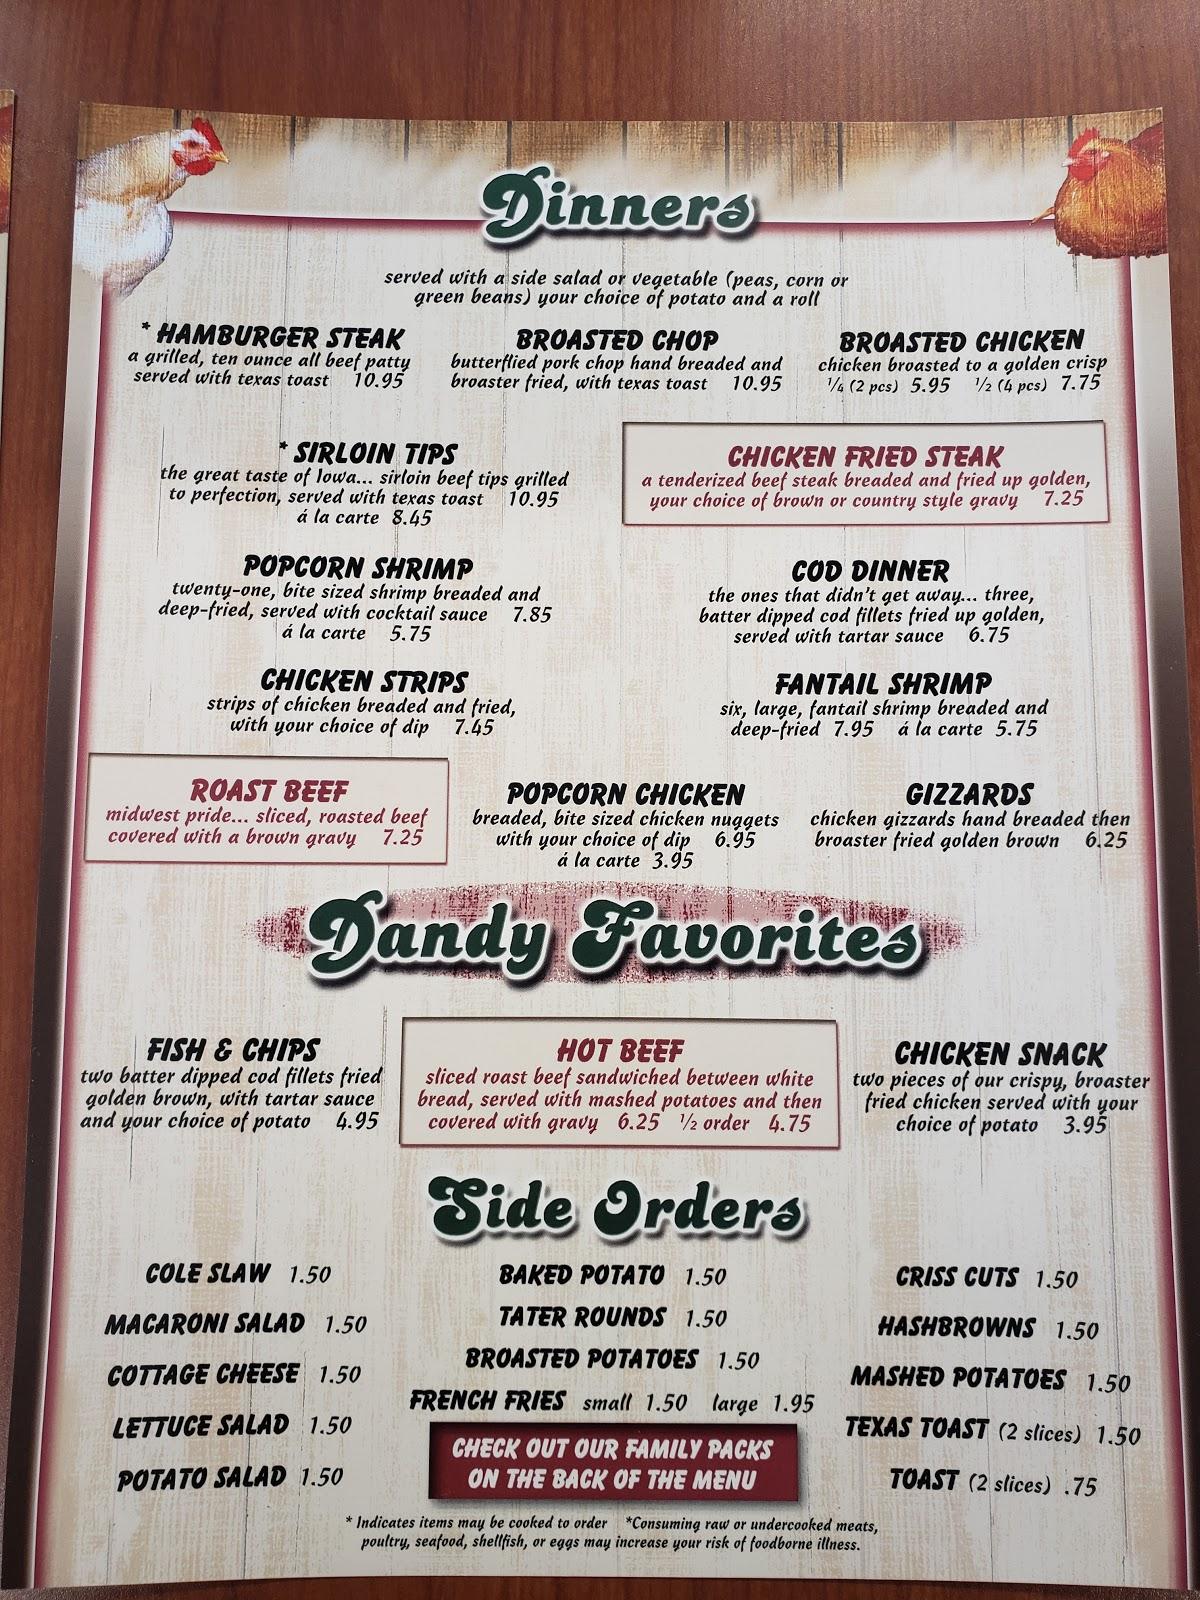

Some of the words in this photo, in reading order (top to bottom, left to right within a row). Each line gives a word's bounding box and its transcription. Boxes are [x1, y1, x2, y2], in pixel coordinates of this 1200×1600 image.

[479, 164, 754, 241] Dinners
[384, 268, 444, 284] served
[449, 268, 488, 285] with
[493, 274, 505, 285] a
[507, 268, 547, 286] side
[552, 268, 603, 286] salad
[608, 273, 626, 286] or
[632, 270, 718, 290] vegetable
[726, 270, 778, 291] (peas,
[786, 276, 824, 288] corn
[830, 276, 849, 288] or
[156, 322, 320, 350] HAMBURGER
[326, 327, 406, 351] STEAK
[516, 328, 644, 352] BROASTED
[652, 329, 719, 352] CHOP
[839, 331, 967, 354] BROASTED
[976, 328, 1085, 353] CHICKEN
[133, 368, 191, 384] served
[195, 369, 232, 385] with
[238, 373, 282, 387] texas
[287, 374, 330, 387] toast
[355, 372, 405, 389] 10.95
[293, 441, 396, 466] SIRLOIN
[405, 442, 459, 466] TIPS
[728, 445, 837, 470] CHICKEN
[844, 446, 918, 470] FRIED
[924, 445, 1005, 469] STEAK
[243, 554, 365, 580] POPCORN
[371, 556, 474, 582] SHRIMP
[792, 559, 843, 582] COD
[851, 559, 950, 584] DINNER
[733, 627, 790, 644] served
[795, 626, 832, 644] with
[838, 630, 890, 644] tartar
[894, 632, 944, 643] sauce
[968, 626, 1010, 644] 6.75
[260, 668, 374, 694] CHICKEN
[380, 670, 470, 695] STRIPS
[775, 672, 879, 696] FANTAIL
[888, 672, 992, 697] SHRIMP
[190, 778, 278, 804] ROAST
[283, 779, 350, 803] BEEF
[507, 782, 628, 807] POPCORN
[635, 782, 746, 808] CHICKEN
[906, 782, 1035, 808] GIZZARDS
[108, 826, 179, 844] covered
[184, 826, 222, 844] with
[228, 833, 240, 844] a
[246, 827, 300, 844] brown
[305, 832, 357, 850] gravy
[383, 828, 424, 846] 7.25
[306, 888, 550, 978] Dandy
[569, 897, 920, 970] Favorites
[146, 1037, 207, 1062] FISH
[214, 1037, 232, 1062] &
[242, 1037, 322, 1062] CHIPS
[557, 1038, 614, 1063] HOT
[619, 1038, 685, 1063] BEEF
[894, 1040, 1011, 1068] CHICKEN
[1018, 1042, 1108, 1068] SNACK
[896, 1114, 952, 1132] choice
[958, 1114, 977, 1136] of
[980, 1118, 1038, 1137] potato
[1063, 1115, 1108, 1134] 3.95
[427, 1174, 573, 1237] Side
[593, 1179, 802, 1236] Orders
[146, 1262, 203, 1284] COLE
[206, 1262, 272, 1284] SLAW
[290, 1265, 332, 1284] 1.50
[499, 1264, 573, 1286] BAKED
[580, 1264, 665, 1286] POTATO
[686, 1268, 727, 1287] 1.50
[896, 1265, 958, 1288] CRISS
[964, 1266, 1020, 1288] CUTS
[1036, 1270, 1078, 1290] 1.50
[104, 1312, 230, 1336] MACARONI
[234, 1312, 306, 1334] SALAD
[326, 1315, 368, 1334] 1.50
[499, 1306, 567, 1328] TATER
[574, 1306, 668, 1328] ROUNDS
[686, 1309, 728, 1328] 1.50
[878, 1315, 1037, 1339] HASHBROWNS
[1056, 1321, 1099, 1341] 1.50
[465, 1347, 580, 1370] BROASTED
[587, 1348, 700, 1370] POTATOES
[719, 1352, 760, 1370] 1.50
[107, 1363, 211, 1387] COTTAGE
[216, 1361, 301, 1385] CHEESE
[320, 1365, 362, 1384] 1.50
[850, 1365, 945, 1388] MASHED
[952, 1366, 1068, 1390] POTATOES
[1088, 1373, 1131, 1394] 1.50
[409, 1389, 498, 1412] FRENCH
[504, 1390, 567, 1412] FRIES
[582, 1392, 633, 1411] small
[647, 1393, 688, 1412] 1.50
[712, 1393, 758, 1417] large
[774, 1394, 815, 1414] 1.95
[112, 1414, 213, 1439] LETTUCE
[217, 1413, 289, 1436] SALAD
[310, 1416, 352, 1435] 1.50
[845, 1416, 913, 1438] TEXAS
[920, 1416, 990, 1440] TOAST
[999, 1422, 1018, 1442] (2
[1024, 1423, 1081, 1444] slices)
[1098, 1425, 1141, 1447] 1.50
[452, 1438, 521, 1460] CHECK
[526, 1438, 570, 1458] OUT
[574, 1438, 619, 1460] OUR
[625, 1439, 703, 1459] FAMILY
[708, 1439, 774, 1461] PACKS
[116, 1466, 208, 1492] POTATO
[214, 1465, 287, 1488] SALAD
[302, 1467, 344, 1487] 1.50
[468, 1468, 499, 1488] ON
[507, 1468, 547, 1488] THE
[552, 1468, 608, 1490] BACK
[614, 1469, 642, 1490] OF
[648, 1470, 688, 1490] THE
[692, 1470, 757, 1490] MENU
[890, 1468, 960, 1491] TOAST
[969, 1473, 988, 1493] (2
[994, 1474, 1051, 1496] slices)
[1064, 1476, 1098, 1497] .75
[356, 1515, 416, 1529] Indicates
[419, 1516, 454, 1528] items
[458, 1519, 485, 1532] may
[490, 1515, 504, 1528] be
[508, 1515, 554, 1529] cooked
[558, 1518, 570, 1529] to
[574, 1516, 608, 1529] order
[705, 1519, 730, 1530] raw
[734, 1521, 747, 1530] or
[750, 1517, 833, 1532] undercooked
[836, 1521, 878, 1535] meats,
[360, 1534, 410, 1551] poultry,
[415, 1533, 468, 1551] seafood,
[472, 1533, 528, 1551] shellfish,
[532, 1538, 546, 1548] or
[550, 1538, 580, 1551] eggs
[584, 1538, 611, 1552] may
[616, 1535, 668, 1548] increase
[672, 1539, 702, 1552] your
[706, 1535, 730, 1549] risk
[734, 1535, 747, 1552] of
[750, 1536, 813, 1552] foodborne
[817, 1536, 860, 1551] illness.
